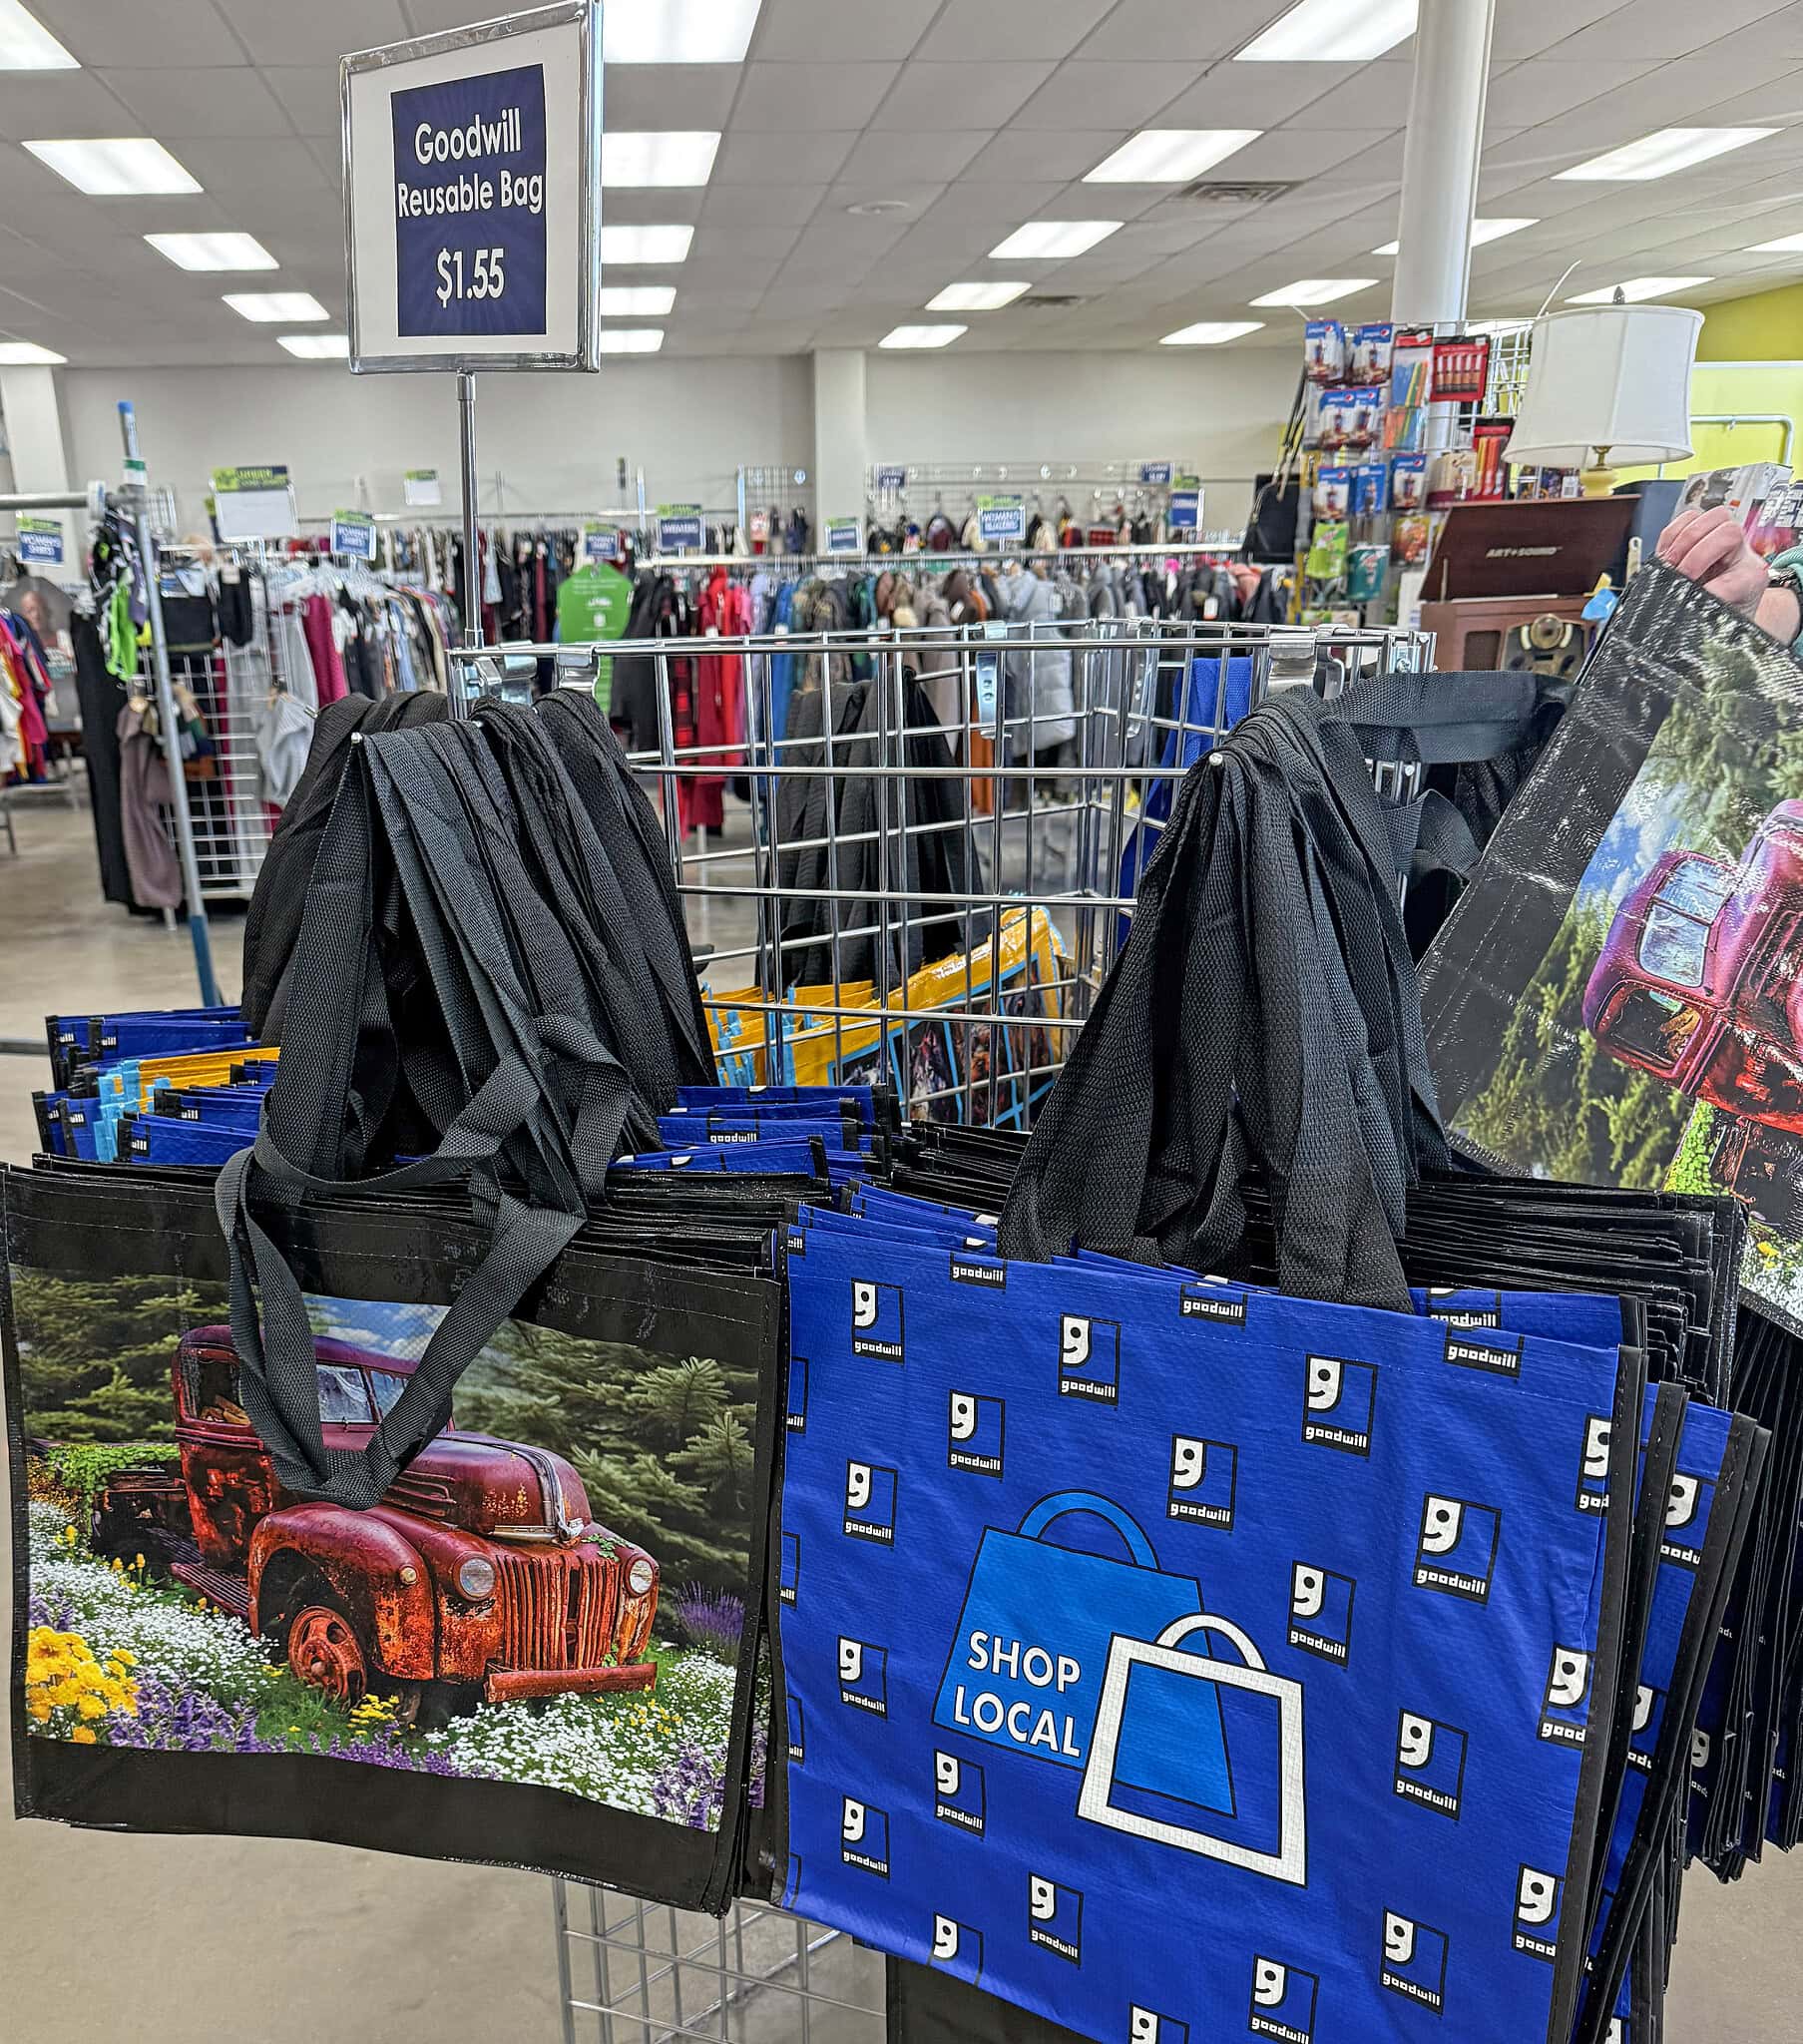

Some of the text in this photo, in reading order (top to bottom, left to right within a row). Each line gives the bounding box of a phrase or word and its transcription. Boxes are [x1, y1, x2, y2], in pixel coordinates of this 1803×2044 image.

[415, 108, 522, 165] Goodwill
[398, 170, 544, 218] Reusable Bag
[437, 249, 505, 308] $1.55
[709, 1132, 757, 1144] goodwill
[952, 1266, 1004, 1282] goodwill
[1182, 1299, 1243, 1318] goodwill
[854, 1340, 902, 1356] goodwill
[1447, 1345, 1518, 1369] goodwill
[1061, 1380, 1116, 1398] goodwill
[1305, 1426, 1368, 1448] goodwill
[950, 1453, 1001, 1471] goodwill
[1169, 1503, 1231, 1523] goodwill
[845, 1521, 892, 1540] goodwill
[1416, 1569, 1486, 1595] goodwill
[1290, 1630, 1346, 1659] goodwill
[967, 1631, 1081, 1693] SHOP
[842, 1691, 885, 1713] goodwill
[954, 1685, 1081, 1758] LOCAL
[1396, 1780, 1457, 1811] goodwill
[936, 1804, 983, 1829] goodwill
[843, 1850, 888, 1873] goodwill
[1031, 1929, 1079, 1958] goodwill
[1382, 1972, 1441, 2006] goodwill
[1251, 2017, 1310, 2044] goodwill
